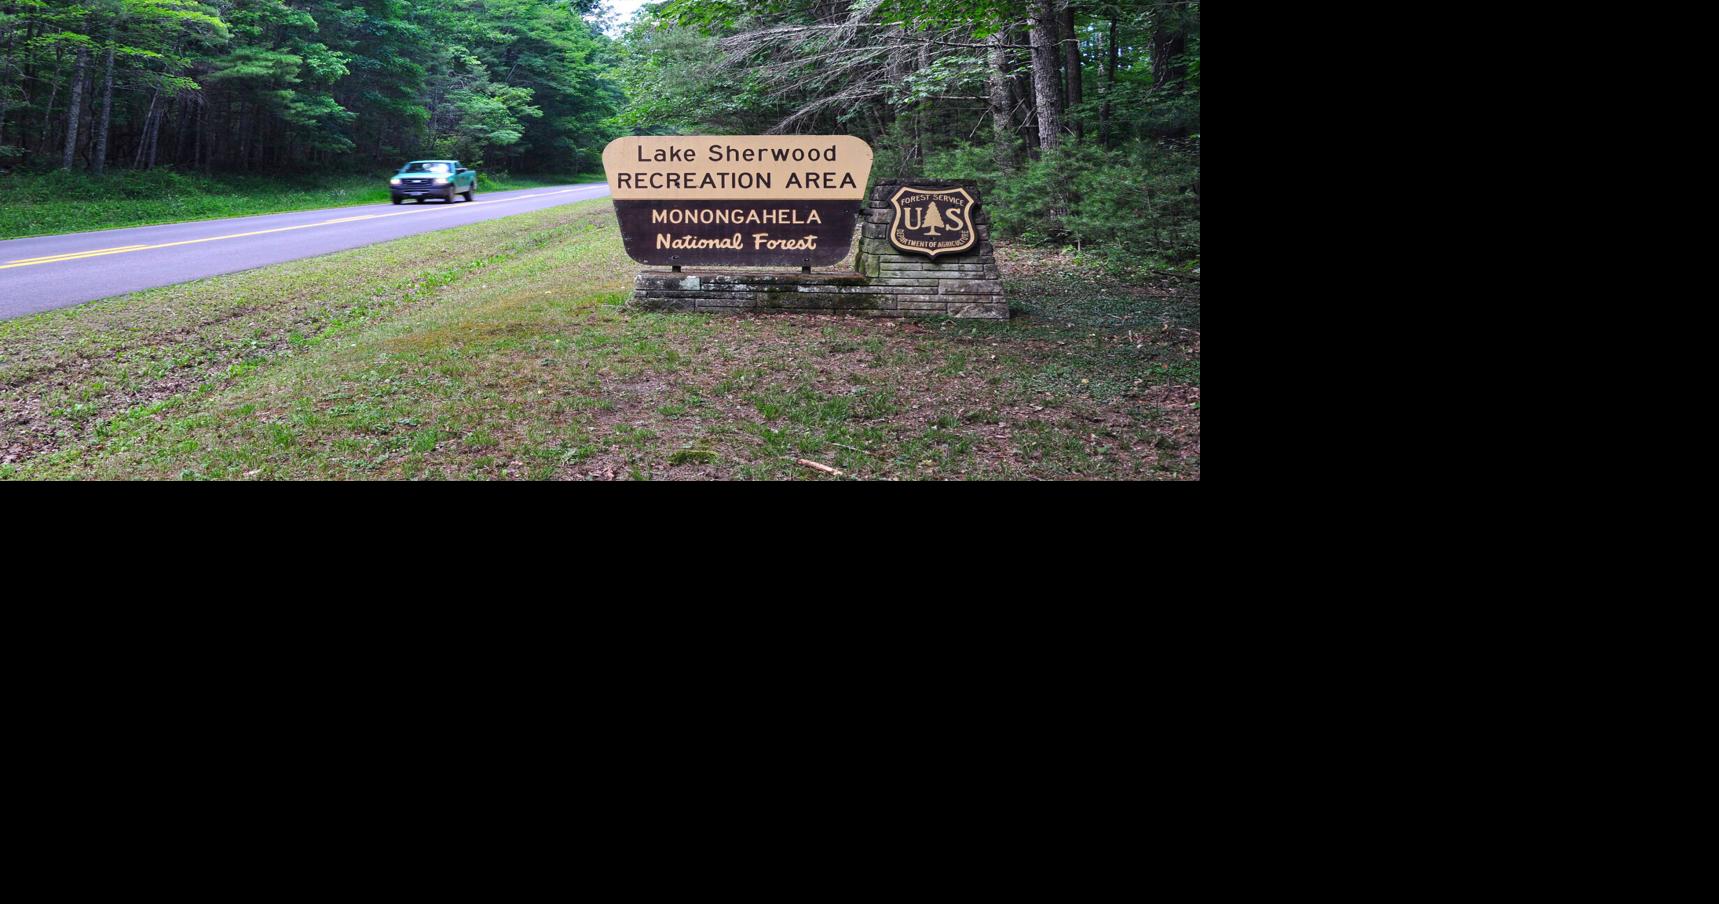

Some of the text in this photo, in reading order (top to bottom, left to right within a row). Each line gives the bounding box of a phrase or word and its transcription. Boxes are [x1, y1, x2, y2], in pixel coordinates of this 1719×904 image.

[637, 144, 837, 162] Lake Sherwood
[617, 172, 857, 189] RECREATION AREA
[901, 195, 965, 207] FOREST SERVICE
[651, 209, 822, 224] MONONGAHELA
[655, 233, 818, 250] National Forest
